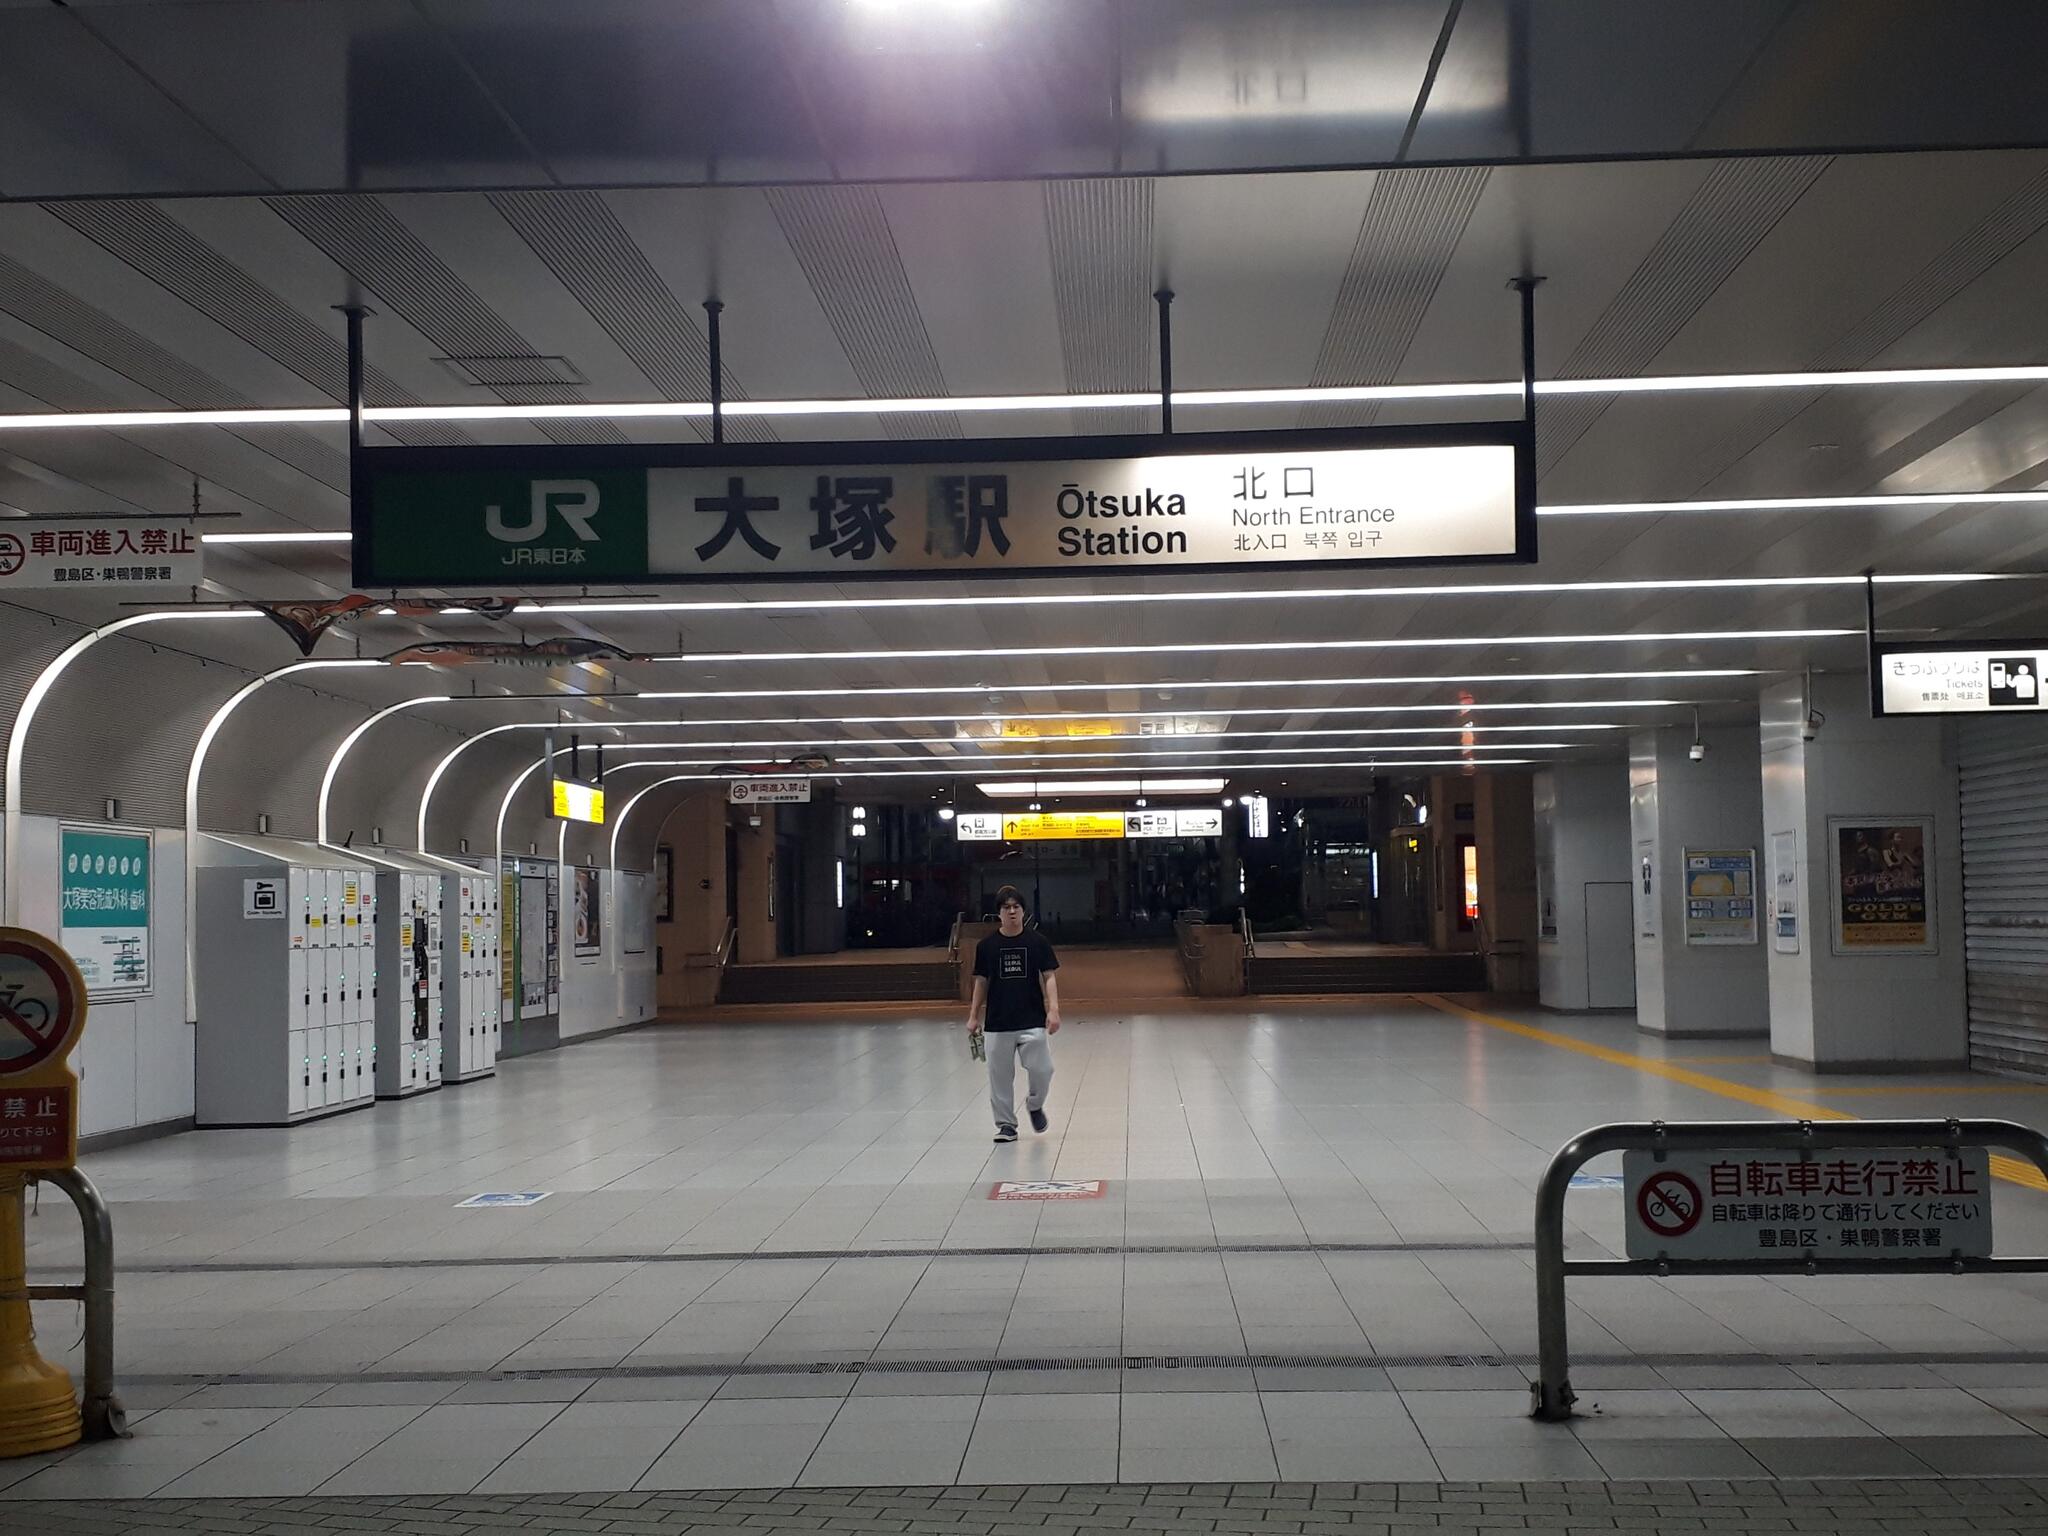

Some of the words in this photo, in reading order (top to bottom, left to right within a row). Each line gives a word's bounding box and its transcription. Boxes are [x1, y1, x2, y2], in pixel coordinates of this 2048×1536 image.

[1233, 466, 1315, 501] 北口
[485, 479, 601, 543] JR
[1056, 483, 1187, 520] Ōtsuka
[694, 474, 1012, 562] 大塚駅
[1233, 508, 1291, 527] North
[1300, 505, 1395, 526] Entrance
[30, 528, 196, 557] 車両進入禁止
[1057, 525, 1188, 557] Station
[1234, 533, 1288, 552] 北入口
[1303, 532, 1339, 550] 북쪽
[1348, 530, 1384, 548] 입구
[502, 547, 586, 565] JR東日本
[4, 1096, 58, 1119] 禁止
[1710, 1158, 1979, 1198] 自転車走行禁止
[1711, 1202, 1980, 1223] 自転車は降りて通行してください
[1758, 1227, 1942, 1249] 豊島区・巣鴨警察署
